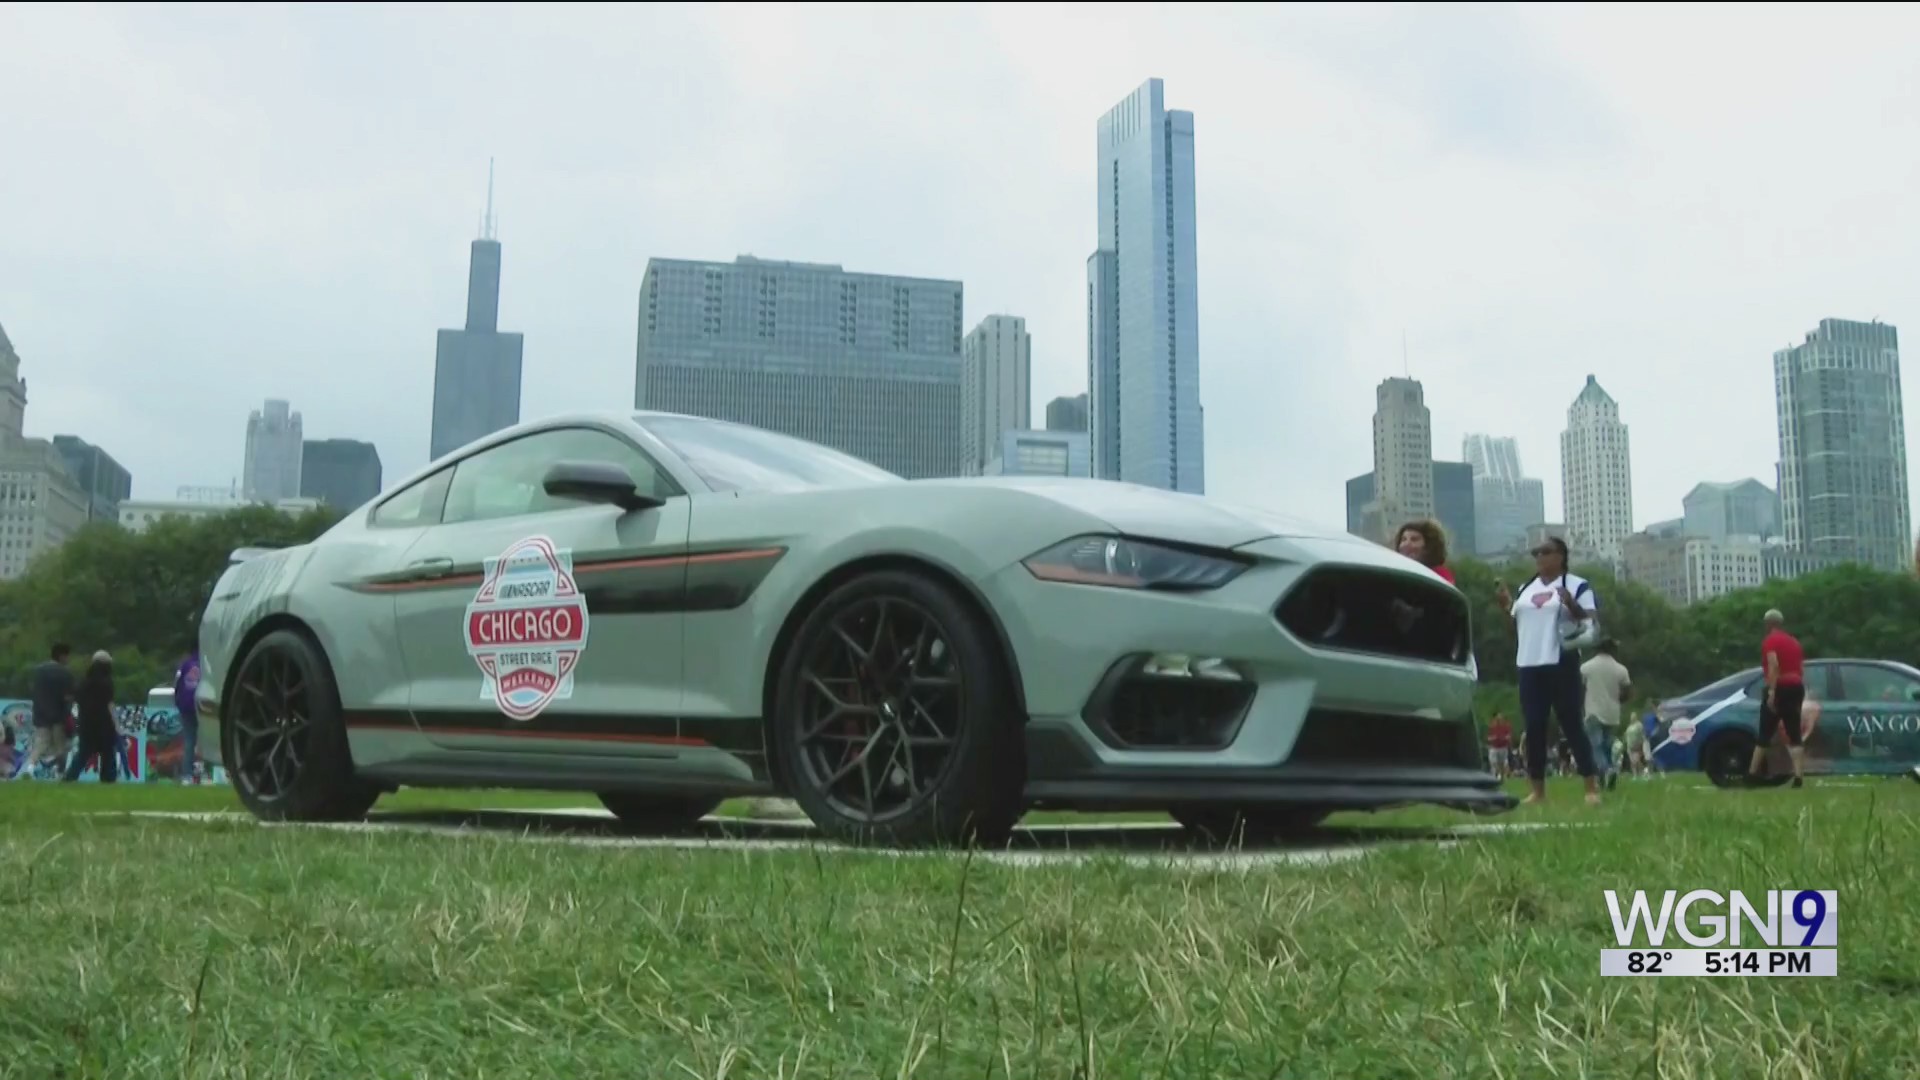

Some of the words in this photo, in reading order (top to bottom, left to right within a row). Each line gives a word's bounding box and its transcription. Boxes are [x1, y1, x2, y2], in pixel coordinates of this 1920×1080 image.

[505, 580, 551, 598] NASCAR
[479, 608, 571, 642] CHICAGO
[500, 652, 529, 666] STREET
[530, 652, 553, 665] RACE
[502, 671, 552, 690] WEEKEND
[1846, 714, 1884, 733] VAN
